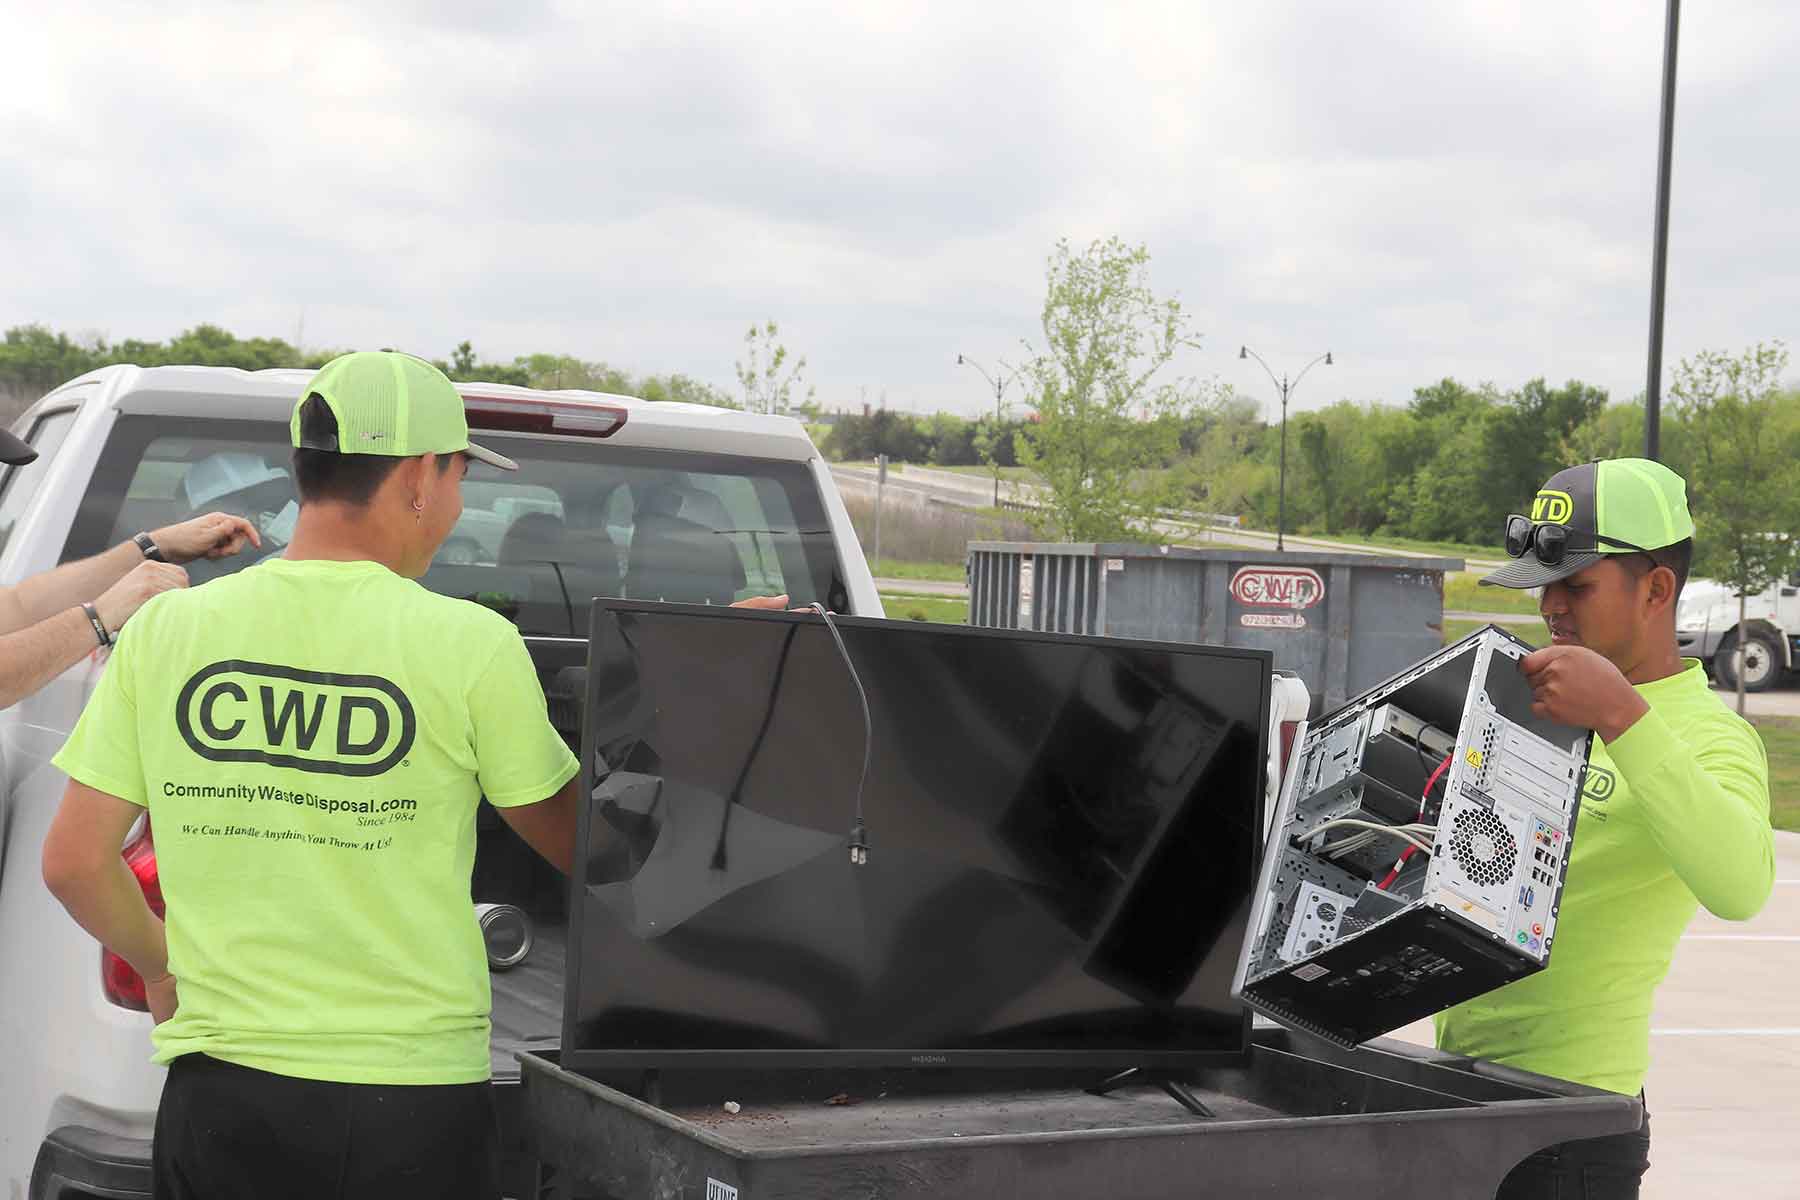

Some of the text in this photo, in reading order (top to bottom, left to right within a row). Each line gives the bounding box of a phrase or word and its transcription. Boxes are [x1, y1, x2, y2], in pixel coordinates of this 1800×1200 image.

[1531, 497, 1567, 520] WD
[200, 681, 390, 755] CWD
[163, 782, 417, 814] CommunityWasteDisposal.com
[357, 812, 416, 826] Since 1984
[182, 824, 199, 834] We
[201, 825, 221, 836] Can
[224, 826, 260, 838] Handle
[306, 834, 326, 845] You
[329, 837, 360, 849] Throw
[362, 842, 375, 851] At
